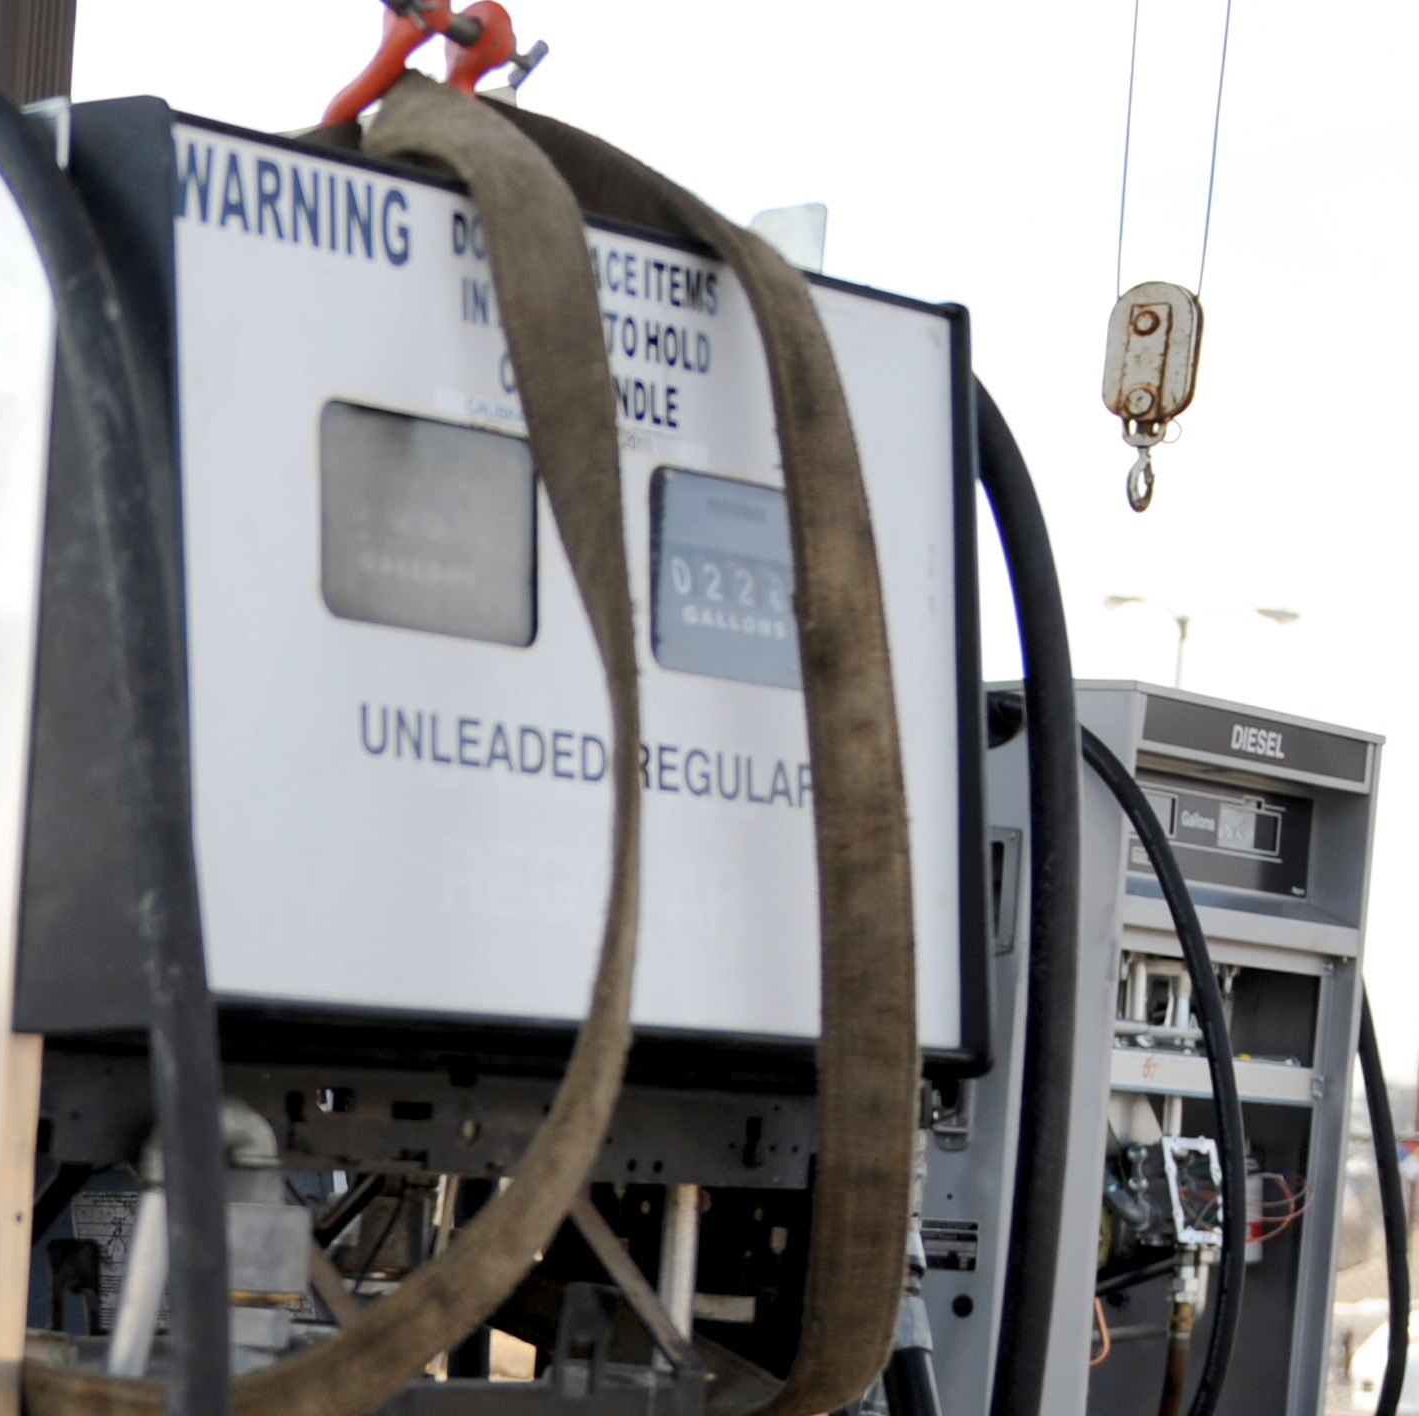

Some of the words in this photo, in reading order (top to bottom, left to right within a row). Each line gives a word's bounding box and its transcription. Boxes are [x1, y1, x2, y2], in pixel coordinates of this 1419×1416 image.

[173, 143, 409, 266] WARNING
[644, 259, 720, 315] ITEMS
[463, 277, 490, 325] IN
[603, 313, 638, 358] TO
[645, 320, 710, 374] HOLD
[614, 376, 679, 428] NDLE
[681, 605, 787, 639] GALLONS
[361, 702, 607, 782] UNLEADED
[1230, 723, 1285, 758] DIESEL
[1181, 810, 1215, 831] Gallons
